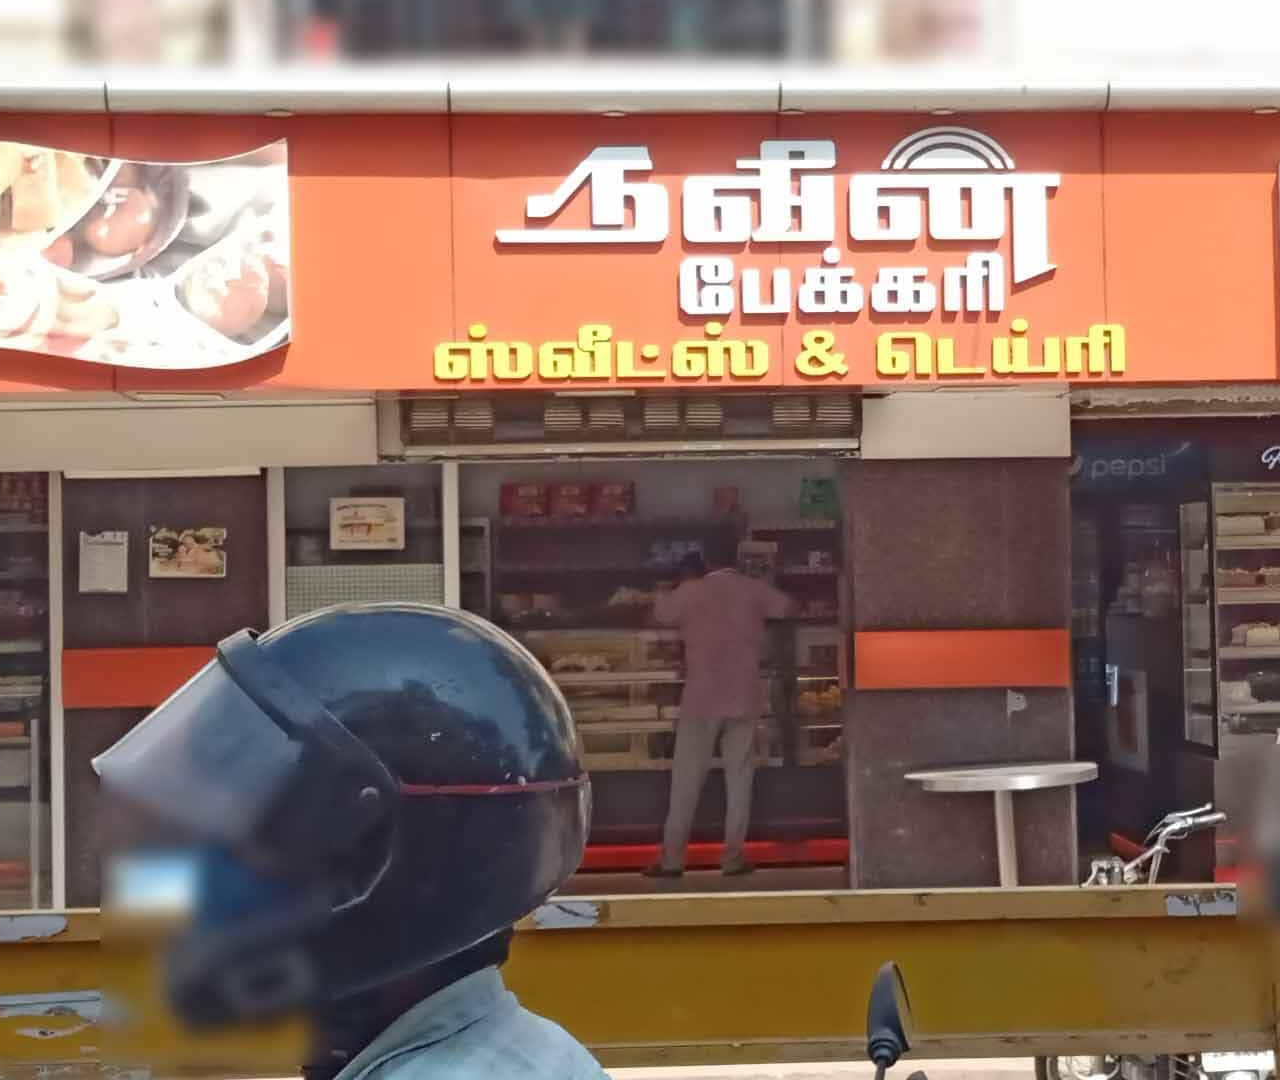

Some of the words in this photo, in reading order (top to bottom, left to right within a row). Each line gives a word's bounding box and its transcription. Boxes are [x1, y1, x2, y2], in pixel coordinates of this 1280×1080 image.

[680, 247, 1004, 314] பேக்கரி
[434, 322, 769, 379] ஸ்வீட்ஸ்
[795, 330, 848, 376] &
[877, 318, 1126, 374] டெய்ரி
[1091, 453, 1167, 480] pepsi
